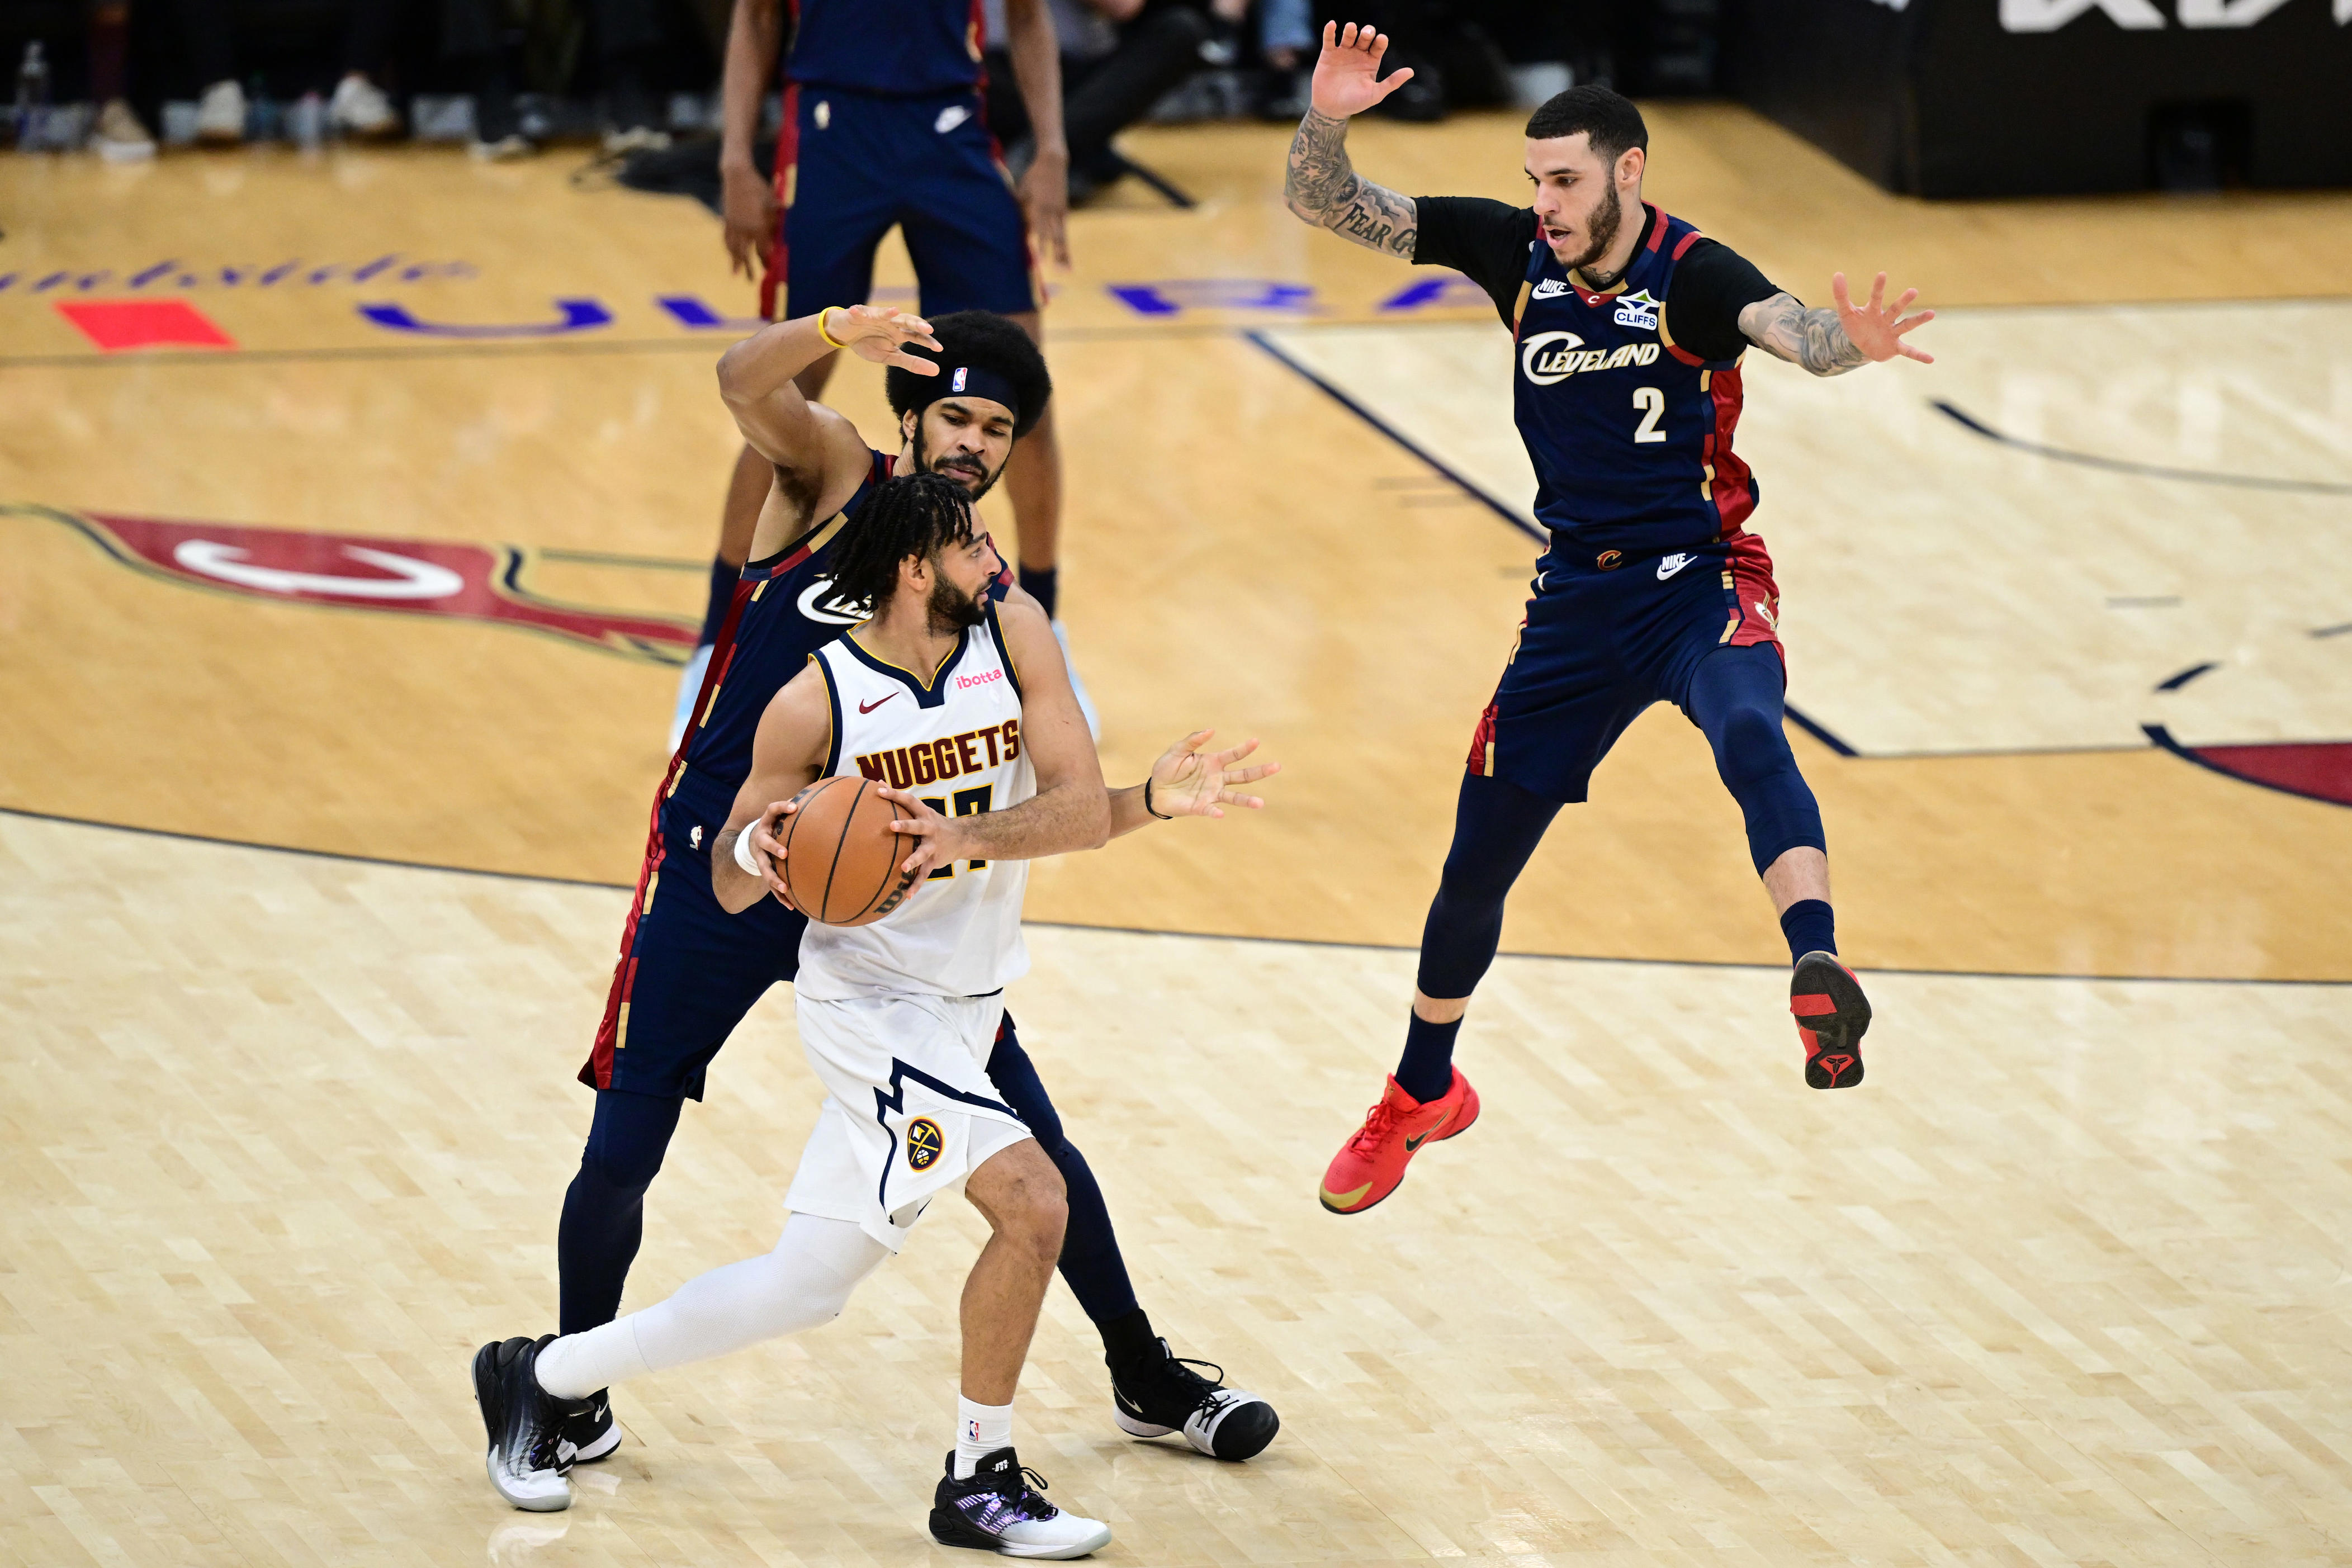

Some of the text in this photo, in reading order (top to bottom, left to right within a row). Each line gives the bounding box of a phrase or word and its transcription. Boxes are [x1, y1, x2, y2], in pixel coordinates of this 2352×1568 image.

[1333, 203, 1392, 248] FEAR
[1539, 278, 1567, 293] NIKE
[1616, 312, 1656, 326] CLIFFS
[1632, 387, 1666, 443] 2
[1661, 553, 1686, 571] NIKE
[955, 669, 1002, 690] ibotta
[855, 718, 1021, 791] NUGGETS
